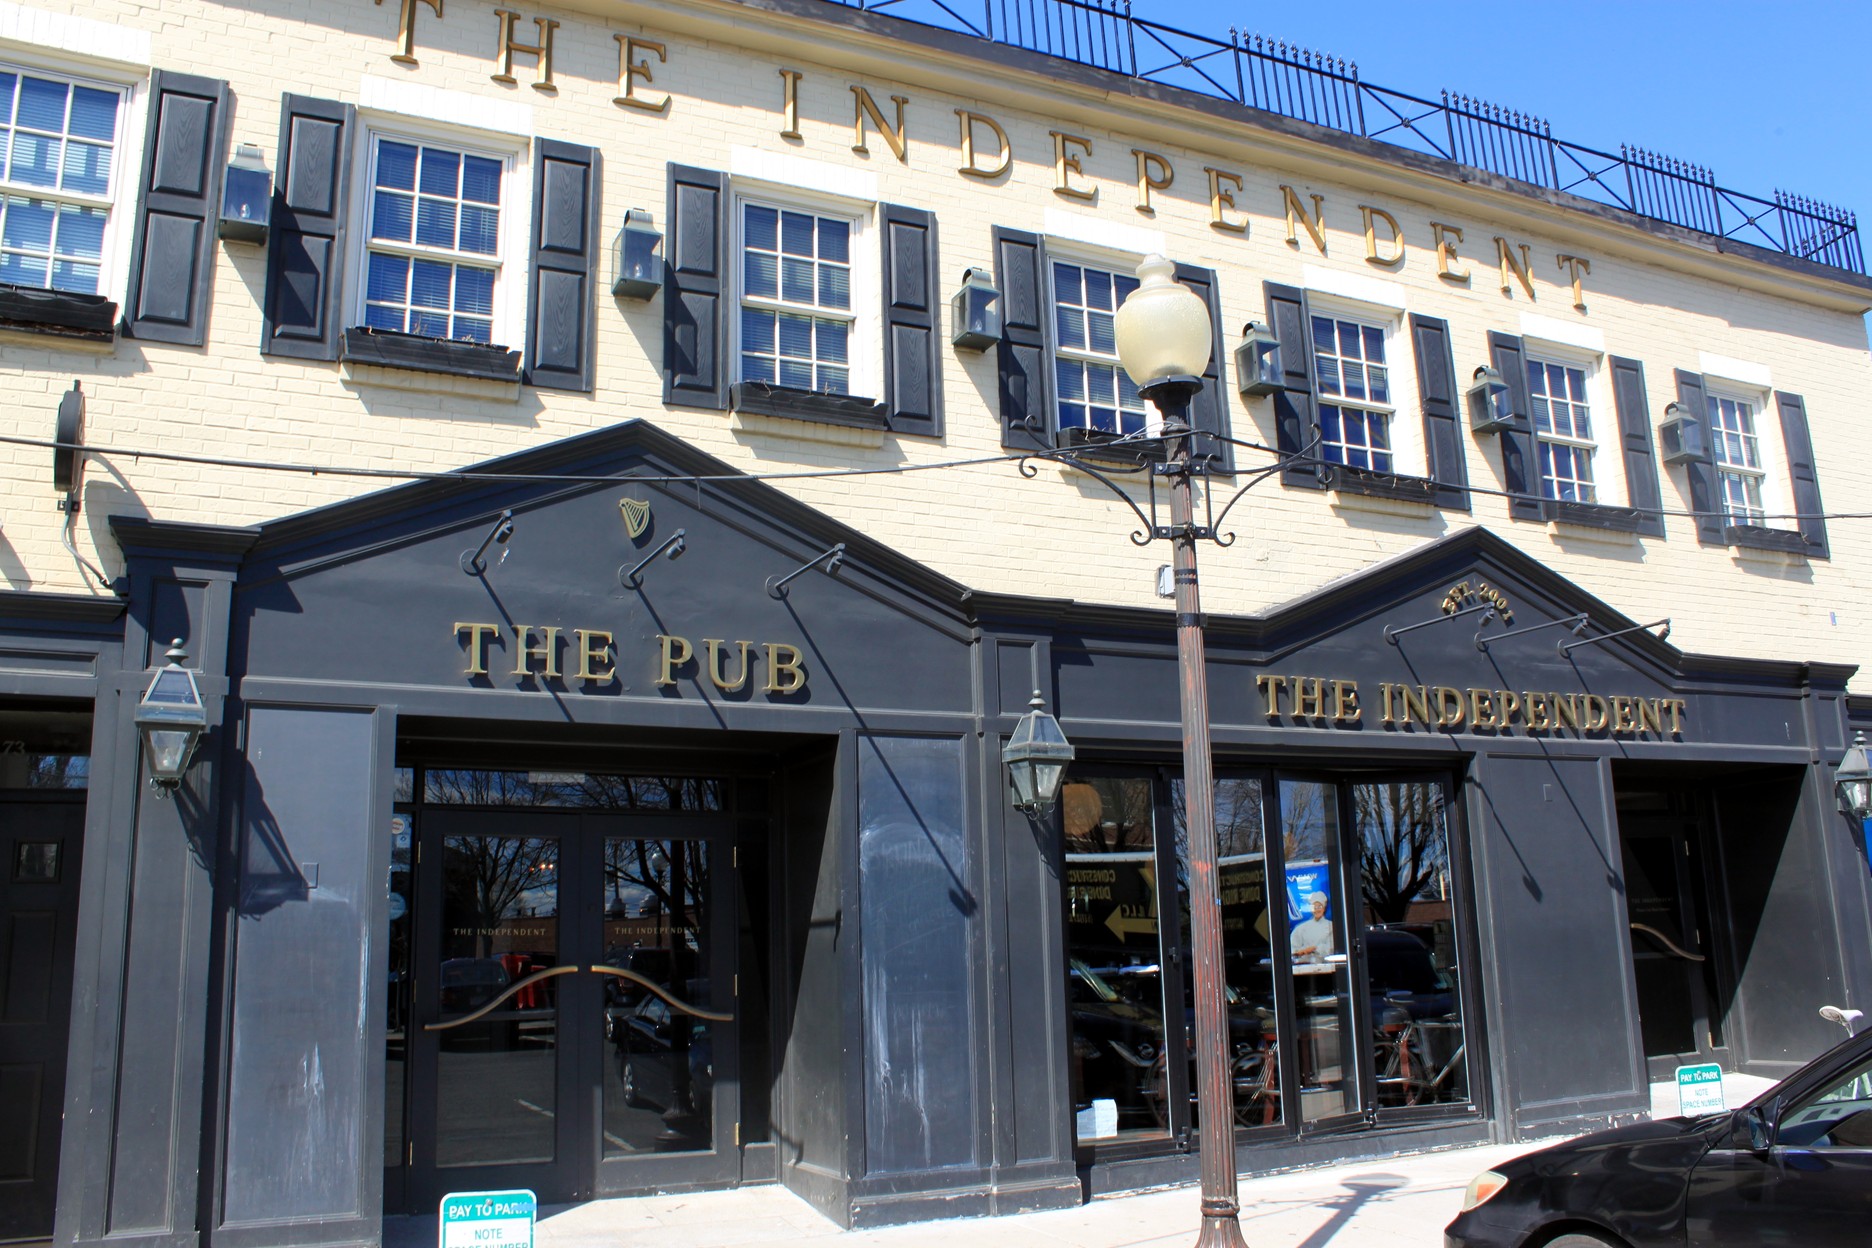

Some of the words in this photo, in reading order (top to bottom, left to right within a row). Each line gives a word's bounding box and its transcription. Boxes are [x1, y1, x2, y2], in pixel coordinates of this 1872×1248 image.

[375, 0, 672, 112] THE
[779, 68, 1591, 311] INDEPENDENT
[1479, 583, 1515, 620] 2001
[453, 622, 616, 680] THE
[654, 634, 806, 692] PUB
[1256, 674, 1361, 721] THE
[1379, 682, 1686, 734] INDEPENDENT
[453, 928, 473, 936] THE
[477, 928, 546, 936] INDEPENDENT
[615, 927, 633, 935] THE
[1680, 1073, 1693, 1083] PAY
[1693, 1072, 1702, 1082] TO
[1702, 1071, 1719, 1081] PARK
[1695, 1088, 1709, 1097] NOTE
[449, 1204, 473, 1219] PAY
[475, 1203, 493, 1217] TO
[475, 1228, 503, 1240] NOTE
